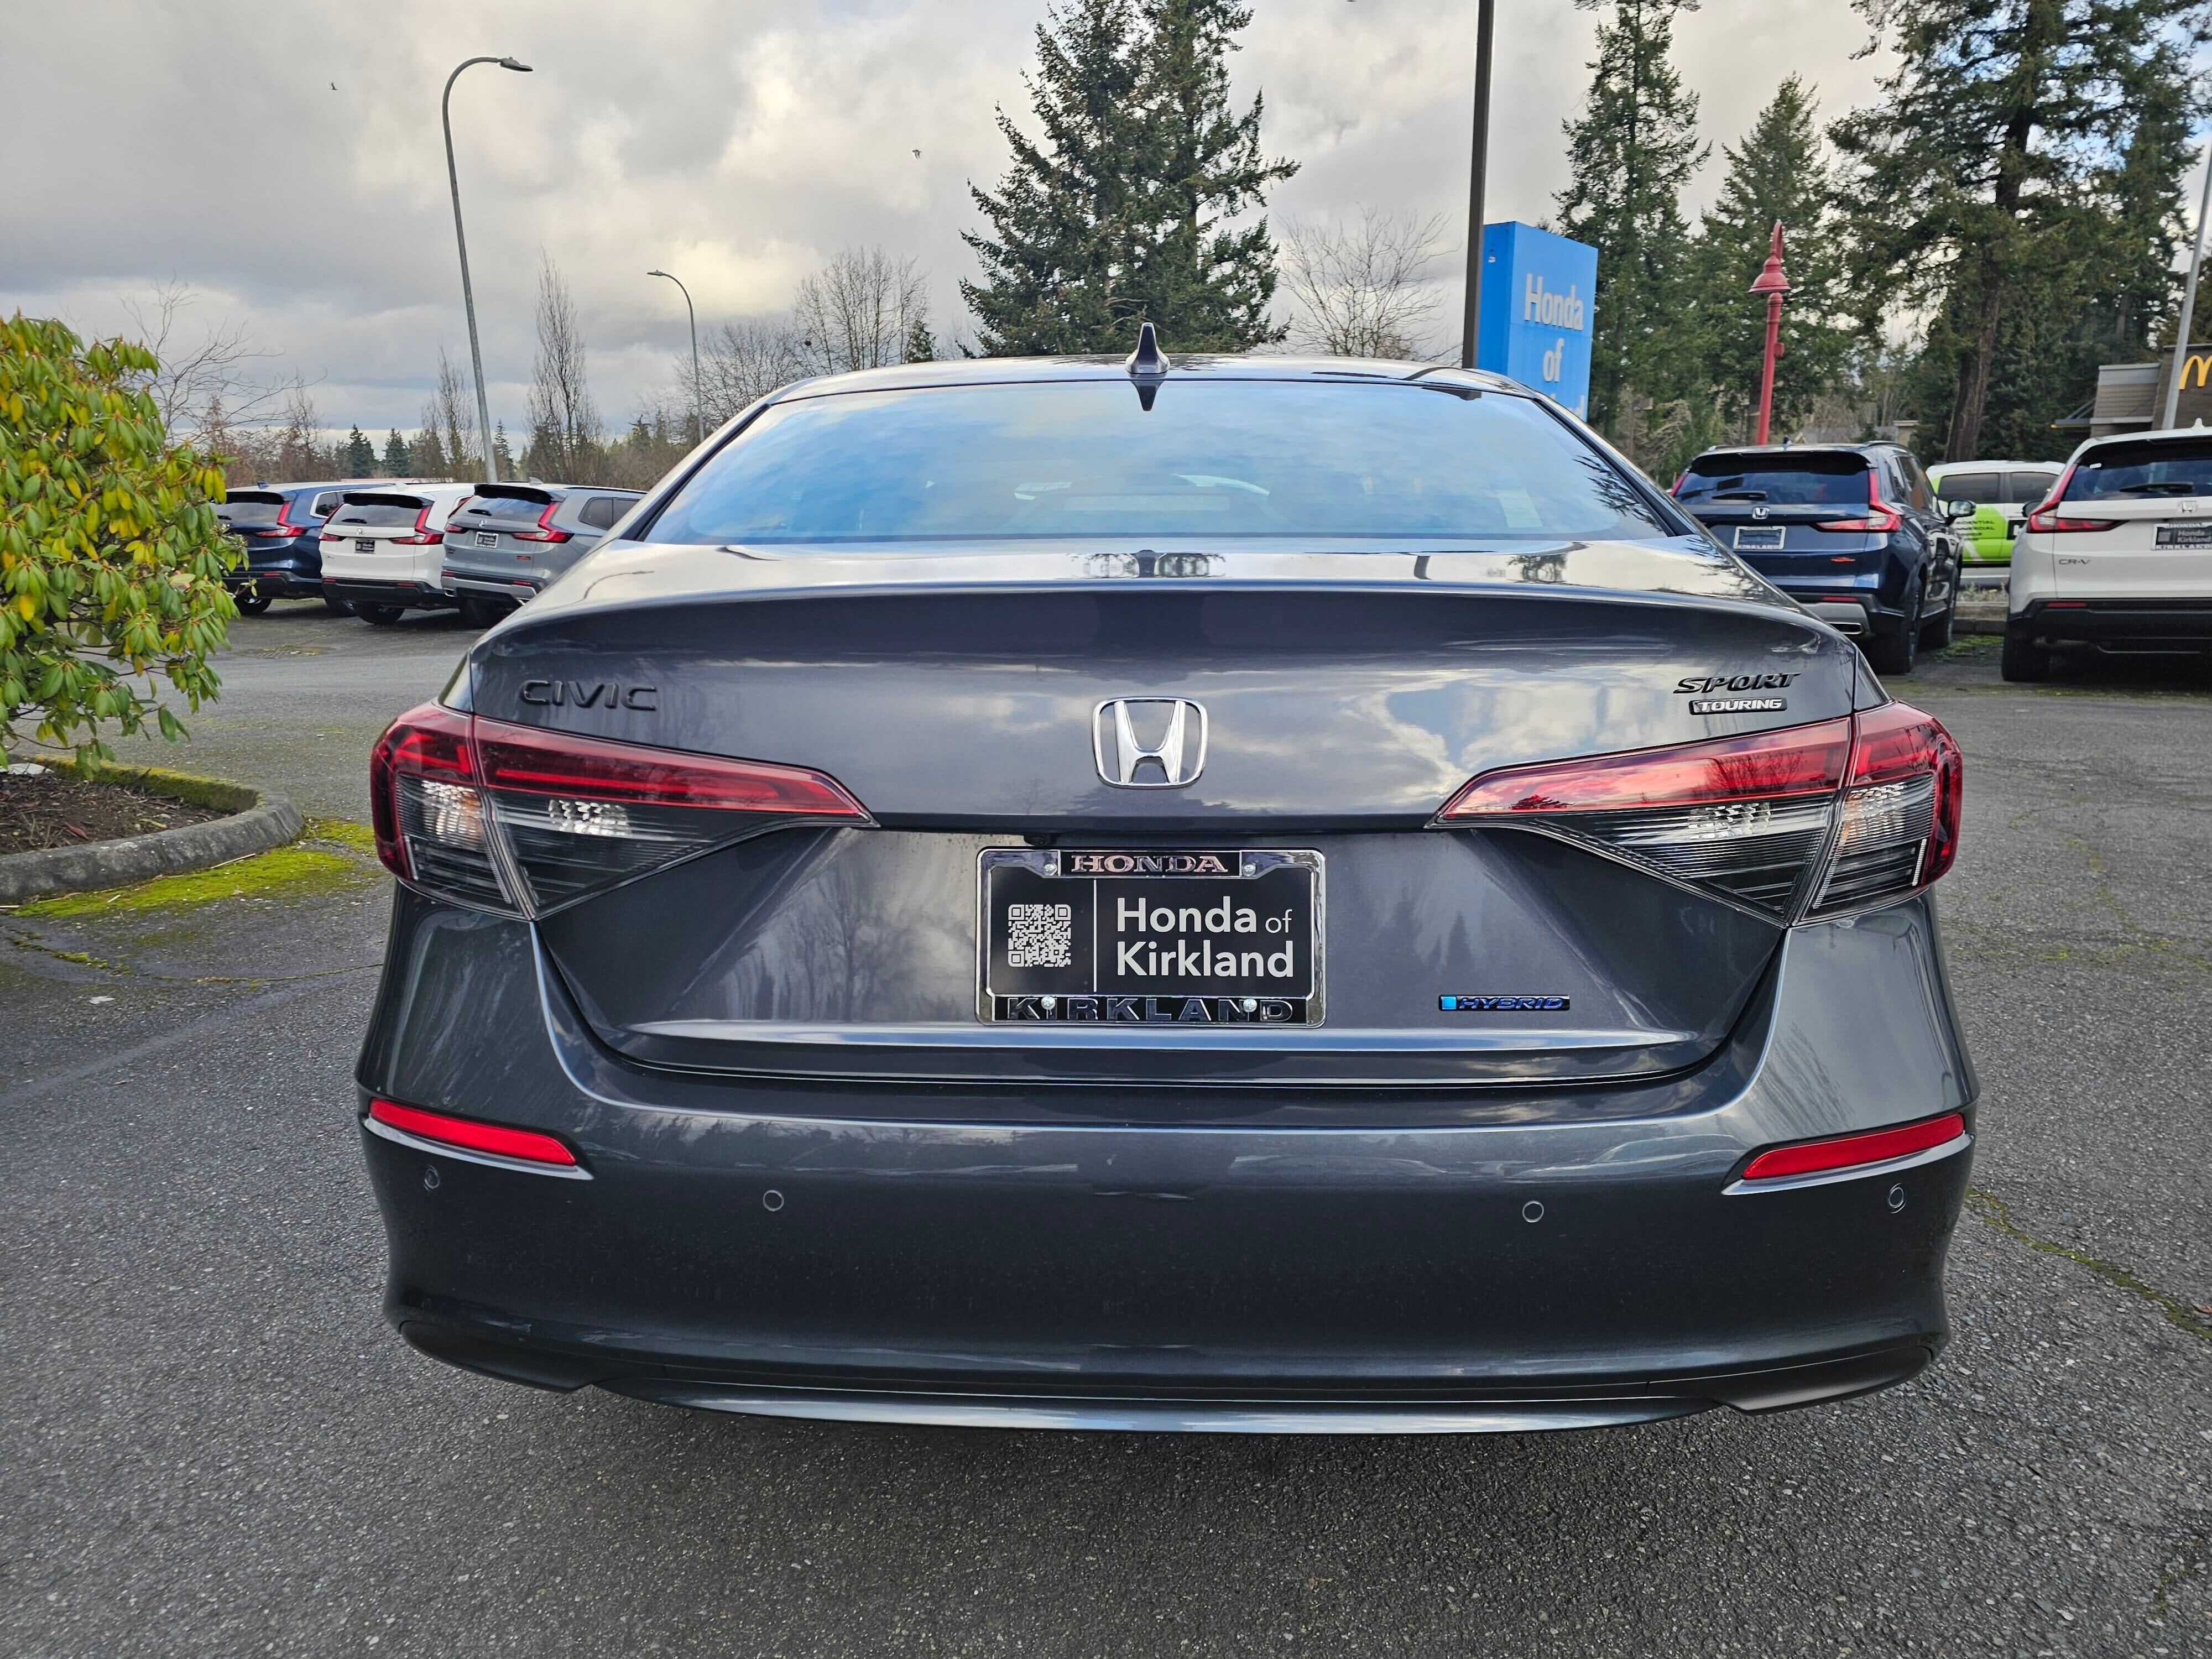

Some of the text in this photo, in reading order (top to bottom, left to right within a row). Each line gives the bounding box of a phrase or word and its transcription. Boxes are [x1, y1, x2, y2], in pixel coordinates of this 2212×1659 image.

[1525, 273, 1584, 331] Honda
[1543, 337, 1564, 382] of
[521, 679, 657, 711] CIVIC
[1673, 672, 1801, 694] SPORT
[1697, 699, 1782, 712] TOURING
[1071, 854, 1228, 873] HONDA
[1117, 896, 1292, 933] Honda of
[1117, 939, 1293, 978] Kirkland
[1459, 997, 1564, 1009] HYBRID
